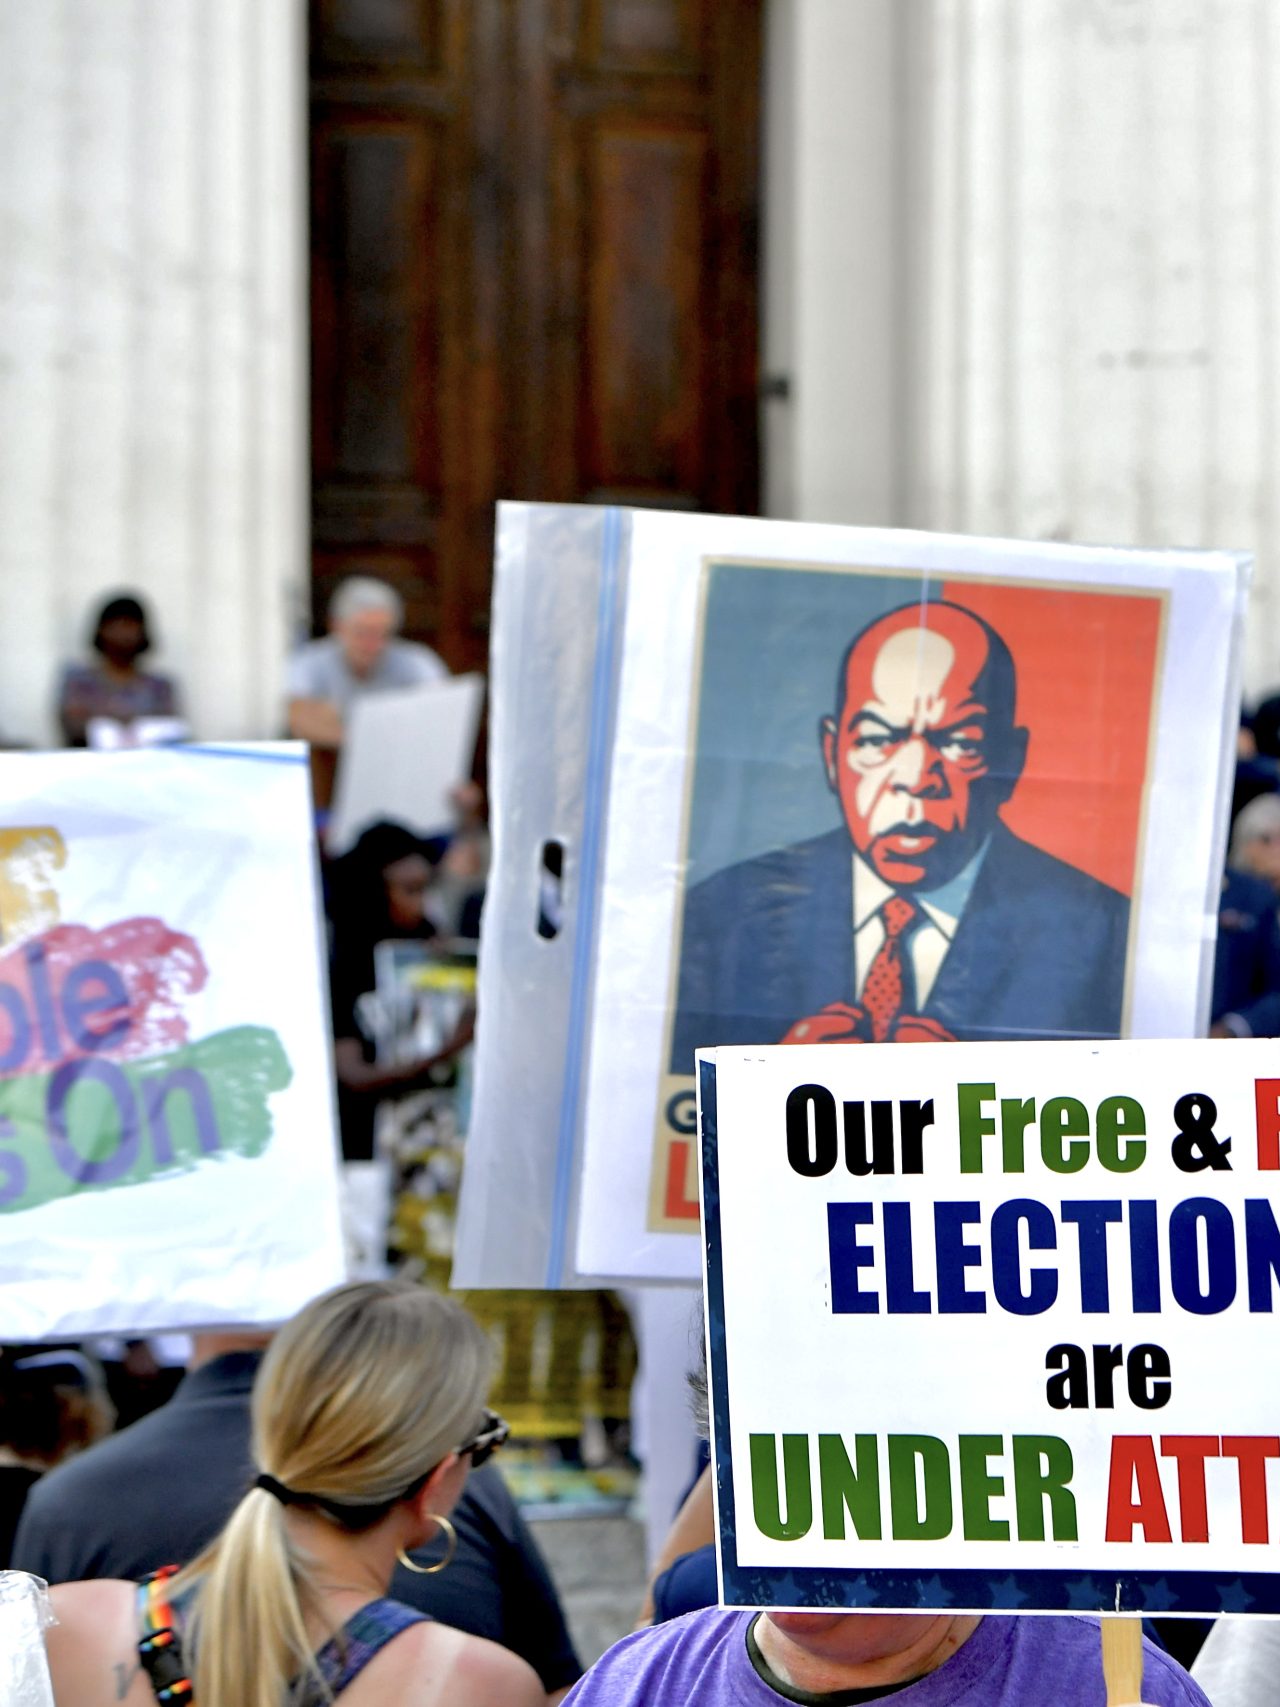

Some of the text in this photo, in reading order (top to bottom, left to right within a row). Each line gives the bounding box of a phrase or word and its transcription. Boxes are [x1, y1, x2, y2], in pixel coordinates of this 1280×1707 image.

[46, 1055, 222, 1185] On
[785, 1084, 934, 1177] Our
[957, 1082, 1146, 1174] Free
[1171, 1093, 1233, 1172] &
[1045, 1342, 1172, 1410] are
[748, 1432, 1078, 1543] UNDER
